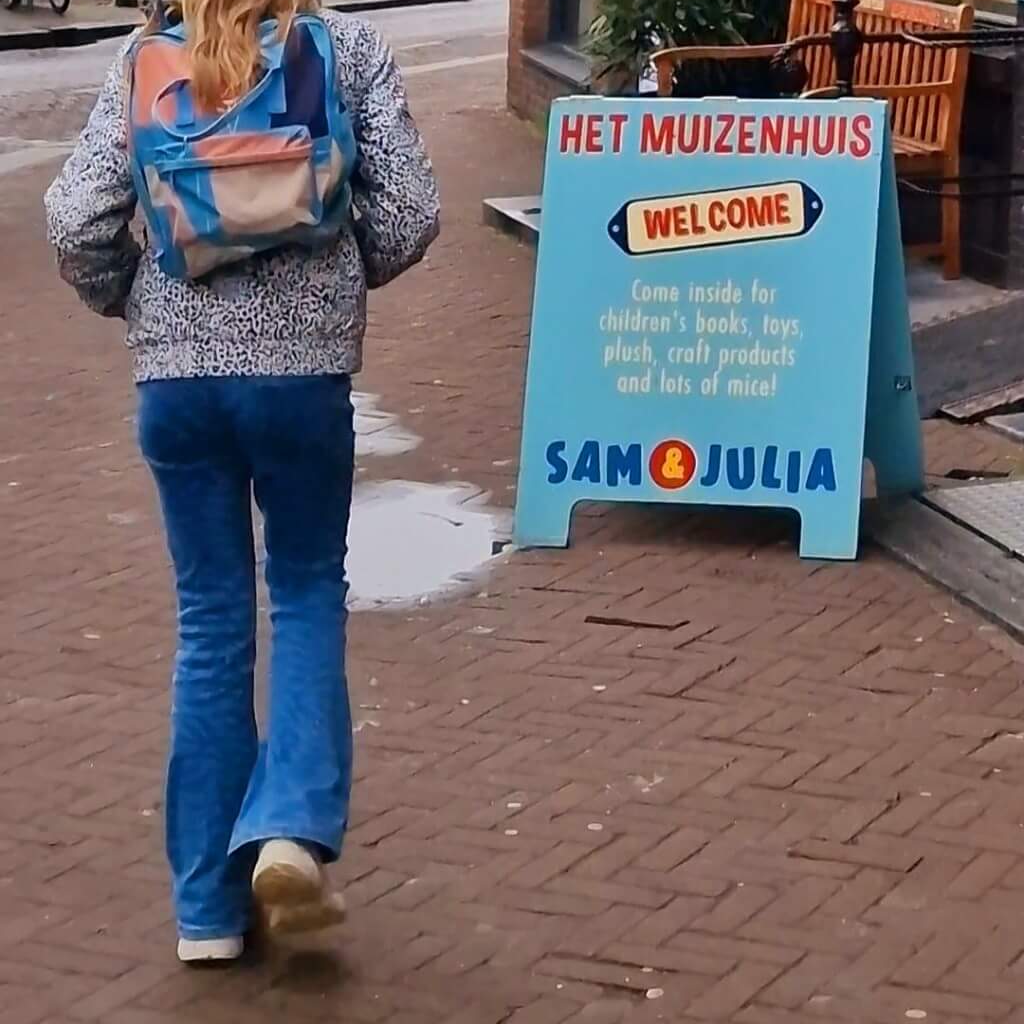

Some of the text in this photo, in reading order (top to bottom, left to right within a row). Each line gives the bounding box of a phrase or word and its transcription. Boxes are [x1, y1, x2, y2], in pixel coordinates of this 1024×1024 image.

[559, 113, 873, 158] HET MUIZENHUIS
[643, 192, 792, 240] WELCOME
[631, 278, 777, 304] Come inside for
[599, 306, 804, 341] children's books, toys,
[604, 336, 796, 371] plush, craft products
[617, 369, 777, 397] and lots of mice!
[545, 440, 837, 493] SAM & JULIA
